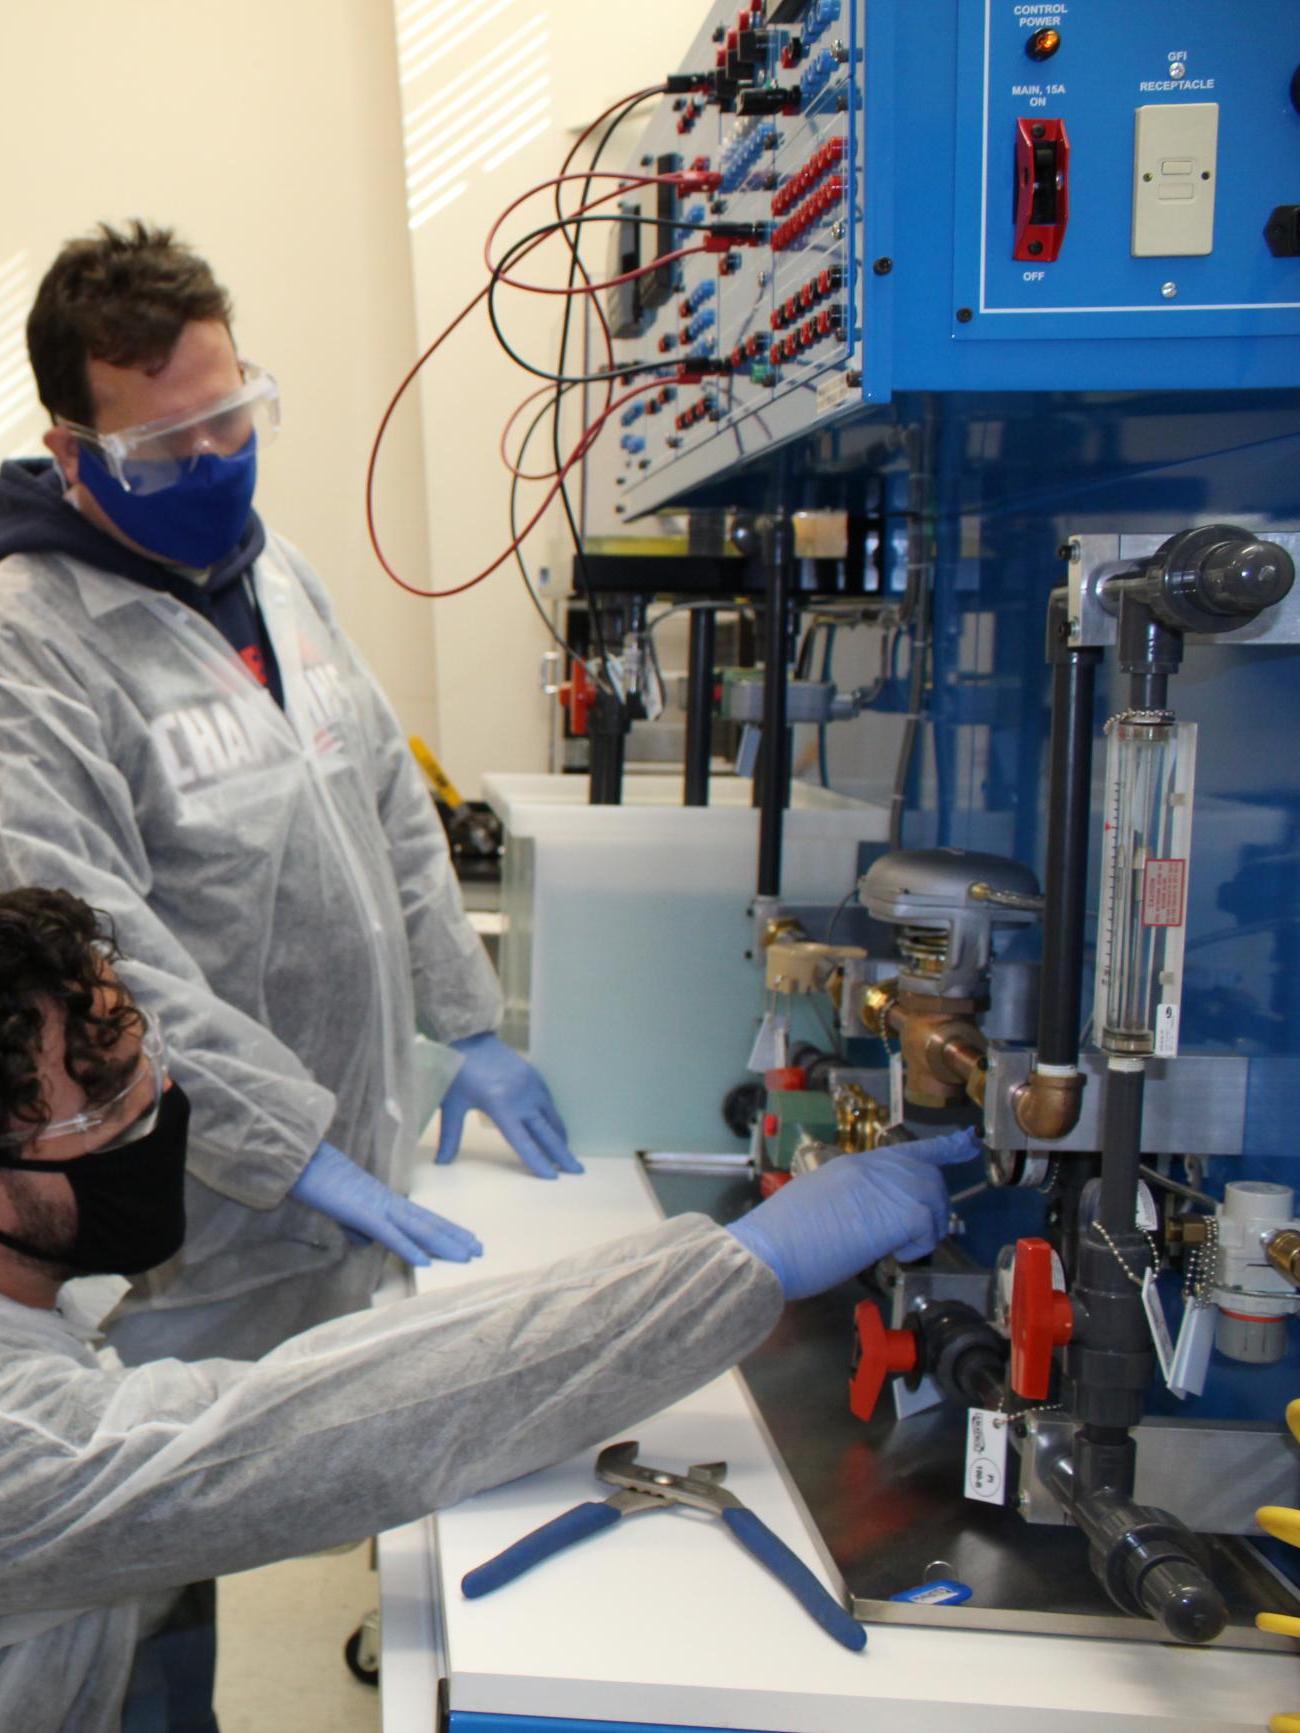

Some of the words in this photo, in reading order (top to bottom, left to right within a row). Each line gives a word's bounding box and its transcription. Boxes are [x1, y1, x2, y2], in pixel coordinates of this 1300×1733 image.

[1013, 3, 1069, 15] CONTROL
[1019, 15, 1061, 27] POWER
[1167, 51, 1188, 62] GFI
[1045, 84, 1066, 95] 15A
[1139, 78, 1215, 92] RECEPTACLE
[1029, 96, 1047, 107] ON
[1022, 271, 1045, 281] OFF
